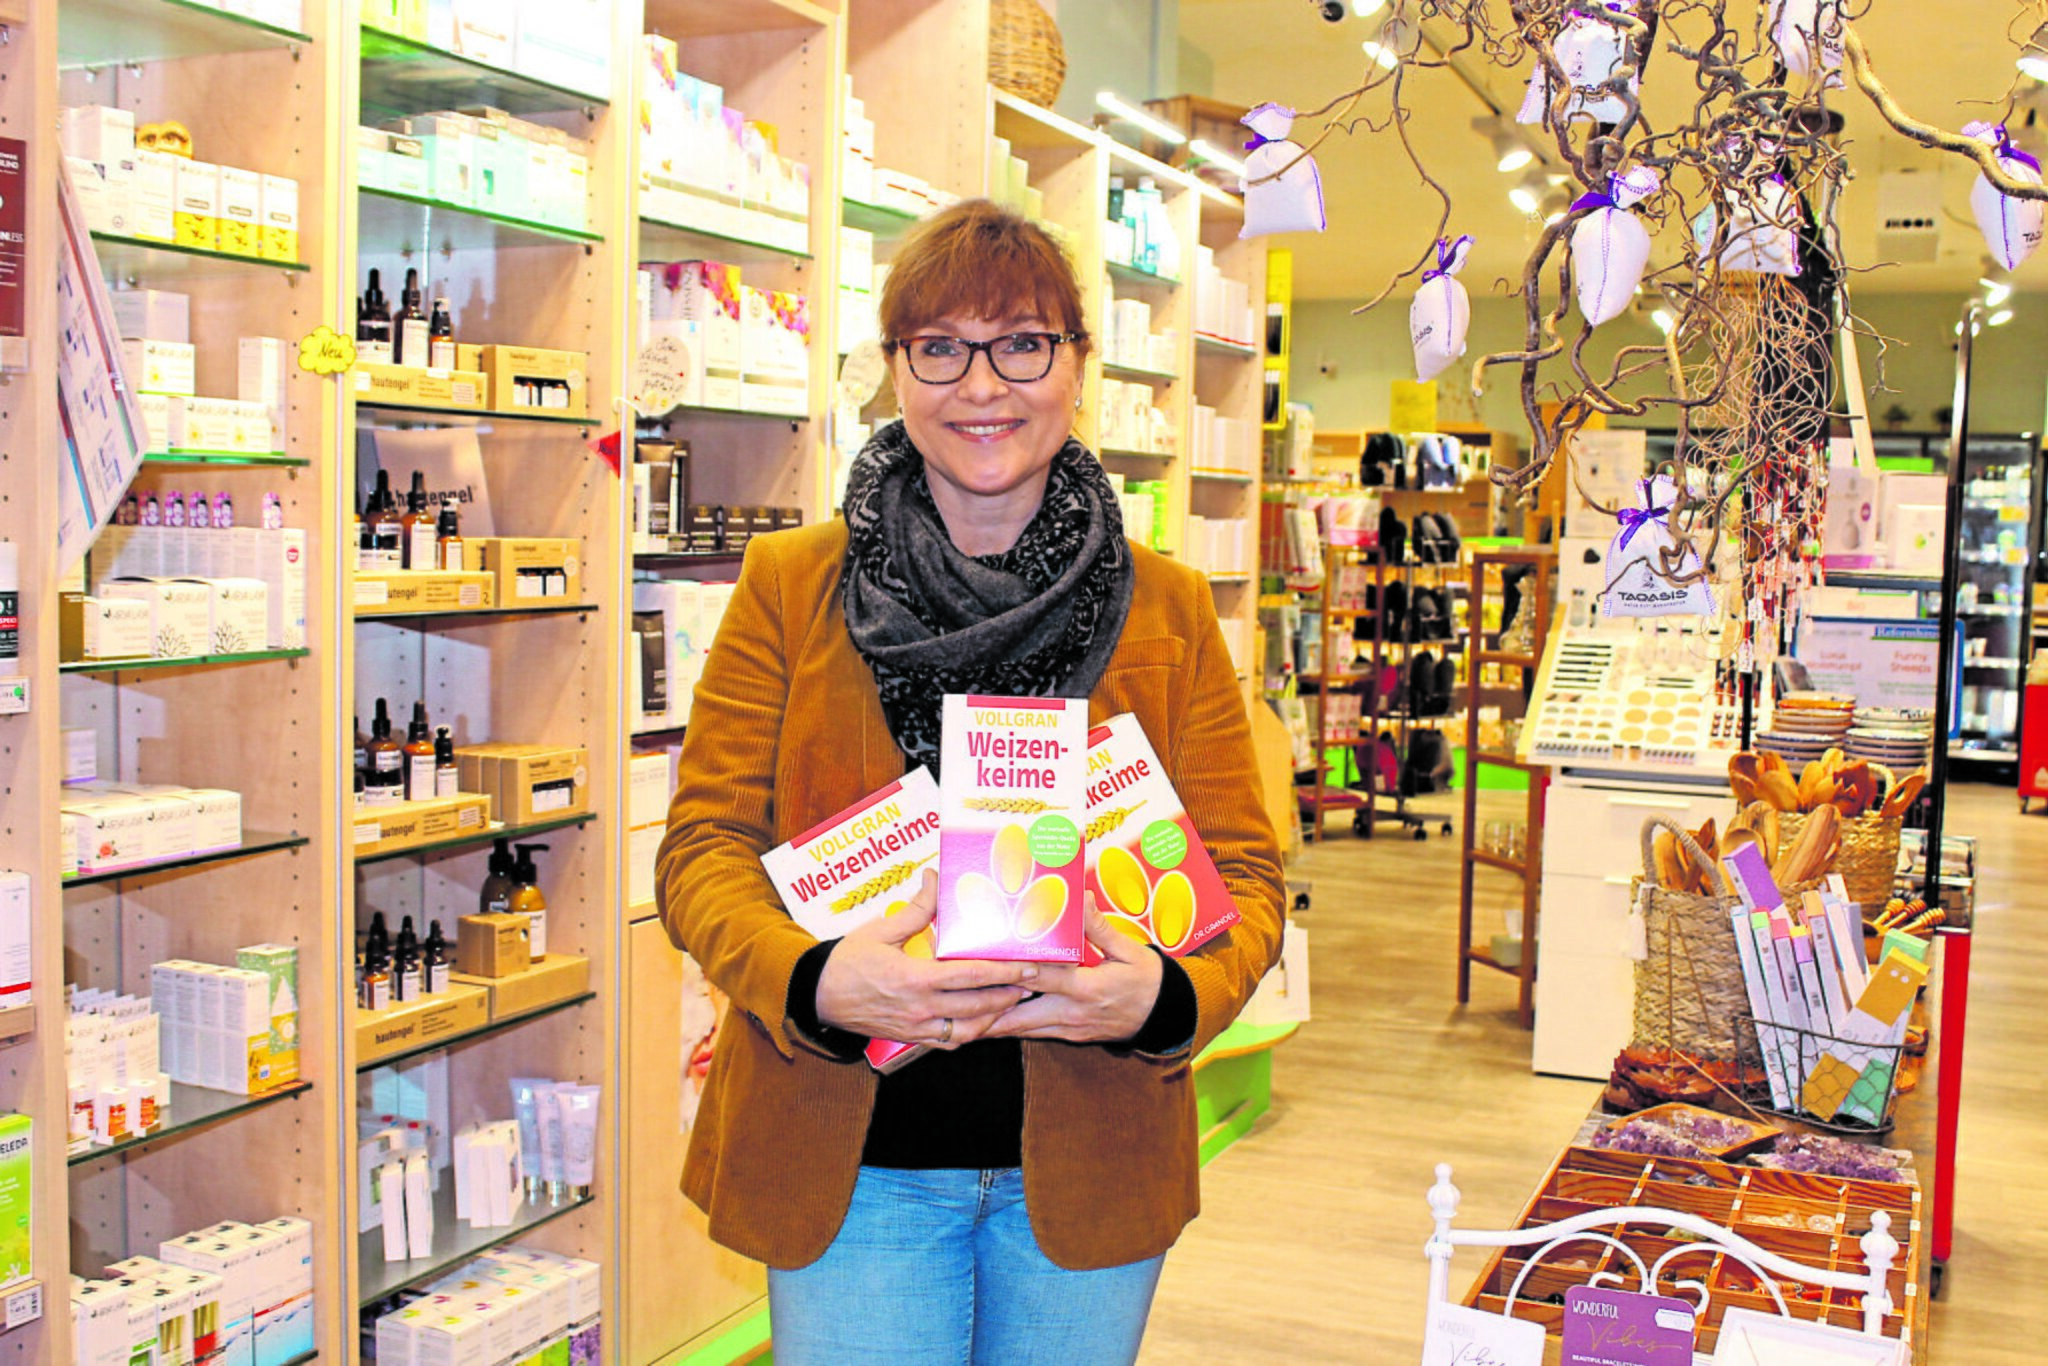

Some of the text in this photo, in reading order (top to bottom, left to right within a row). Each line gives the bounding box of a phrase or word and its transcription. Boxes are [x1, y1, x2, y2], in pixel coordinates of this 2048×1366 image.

[320, 342, 343, 359] Neu
[396, 485, 474, 508] htengel
[1618, 590, 1688, 602] TAOASIS
[975, 711, 1058, 728] VOLLGRAN
[967, 731, 1069, 760] Weizen-
[1087, 748, 1113, 776] AN
[977, 759, 1056, 789] keime
[808, 802, 903, 863] VOLLGRAN
[790, 811, 940, 903] Weizenkeime
[375, 1023, 415, 1044] hautengel
[1572, 1299, 1619, 1320] WONDERFUL
[1587, 1321, 1683, 1352] Vibes
[1572, 1354, 1601, 1365] BEAUTIFUL
